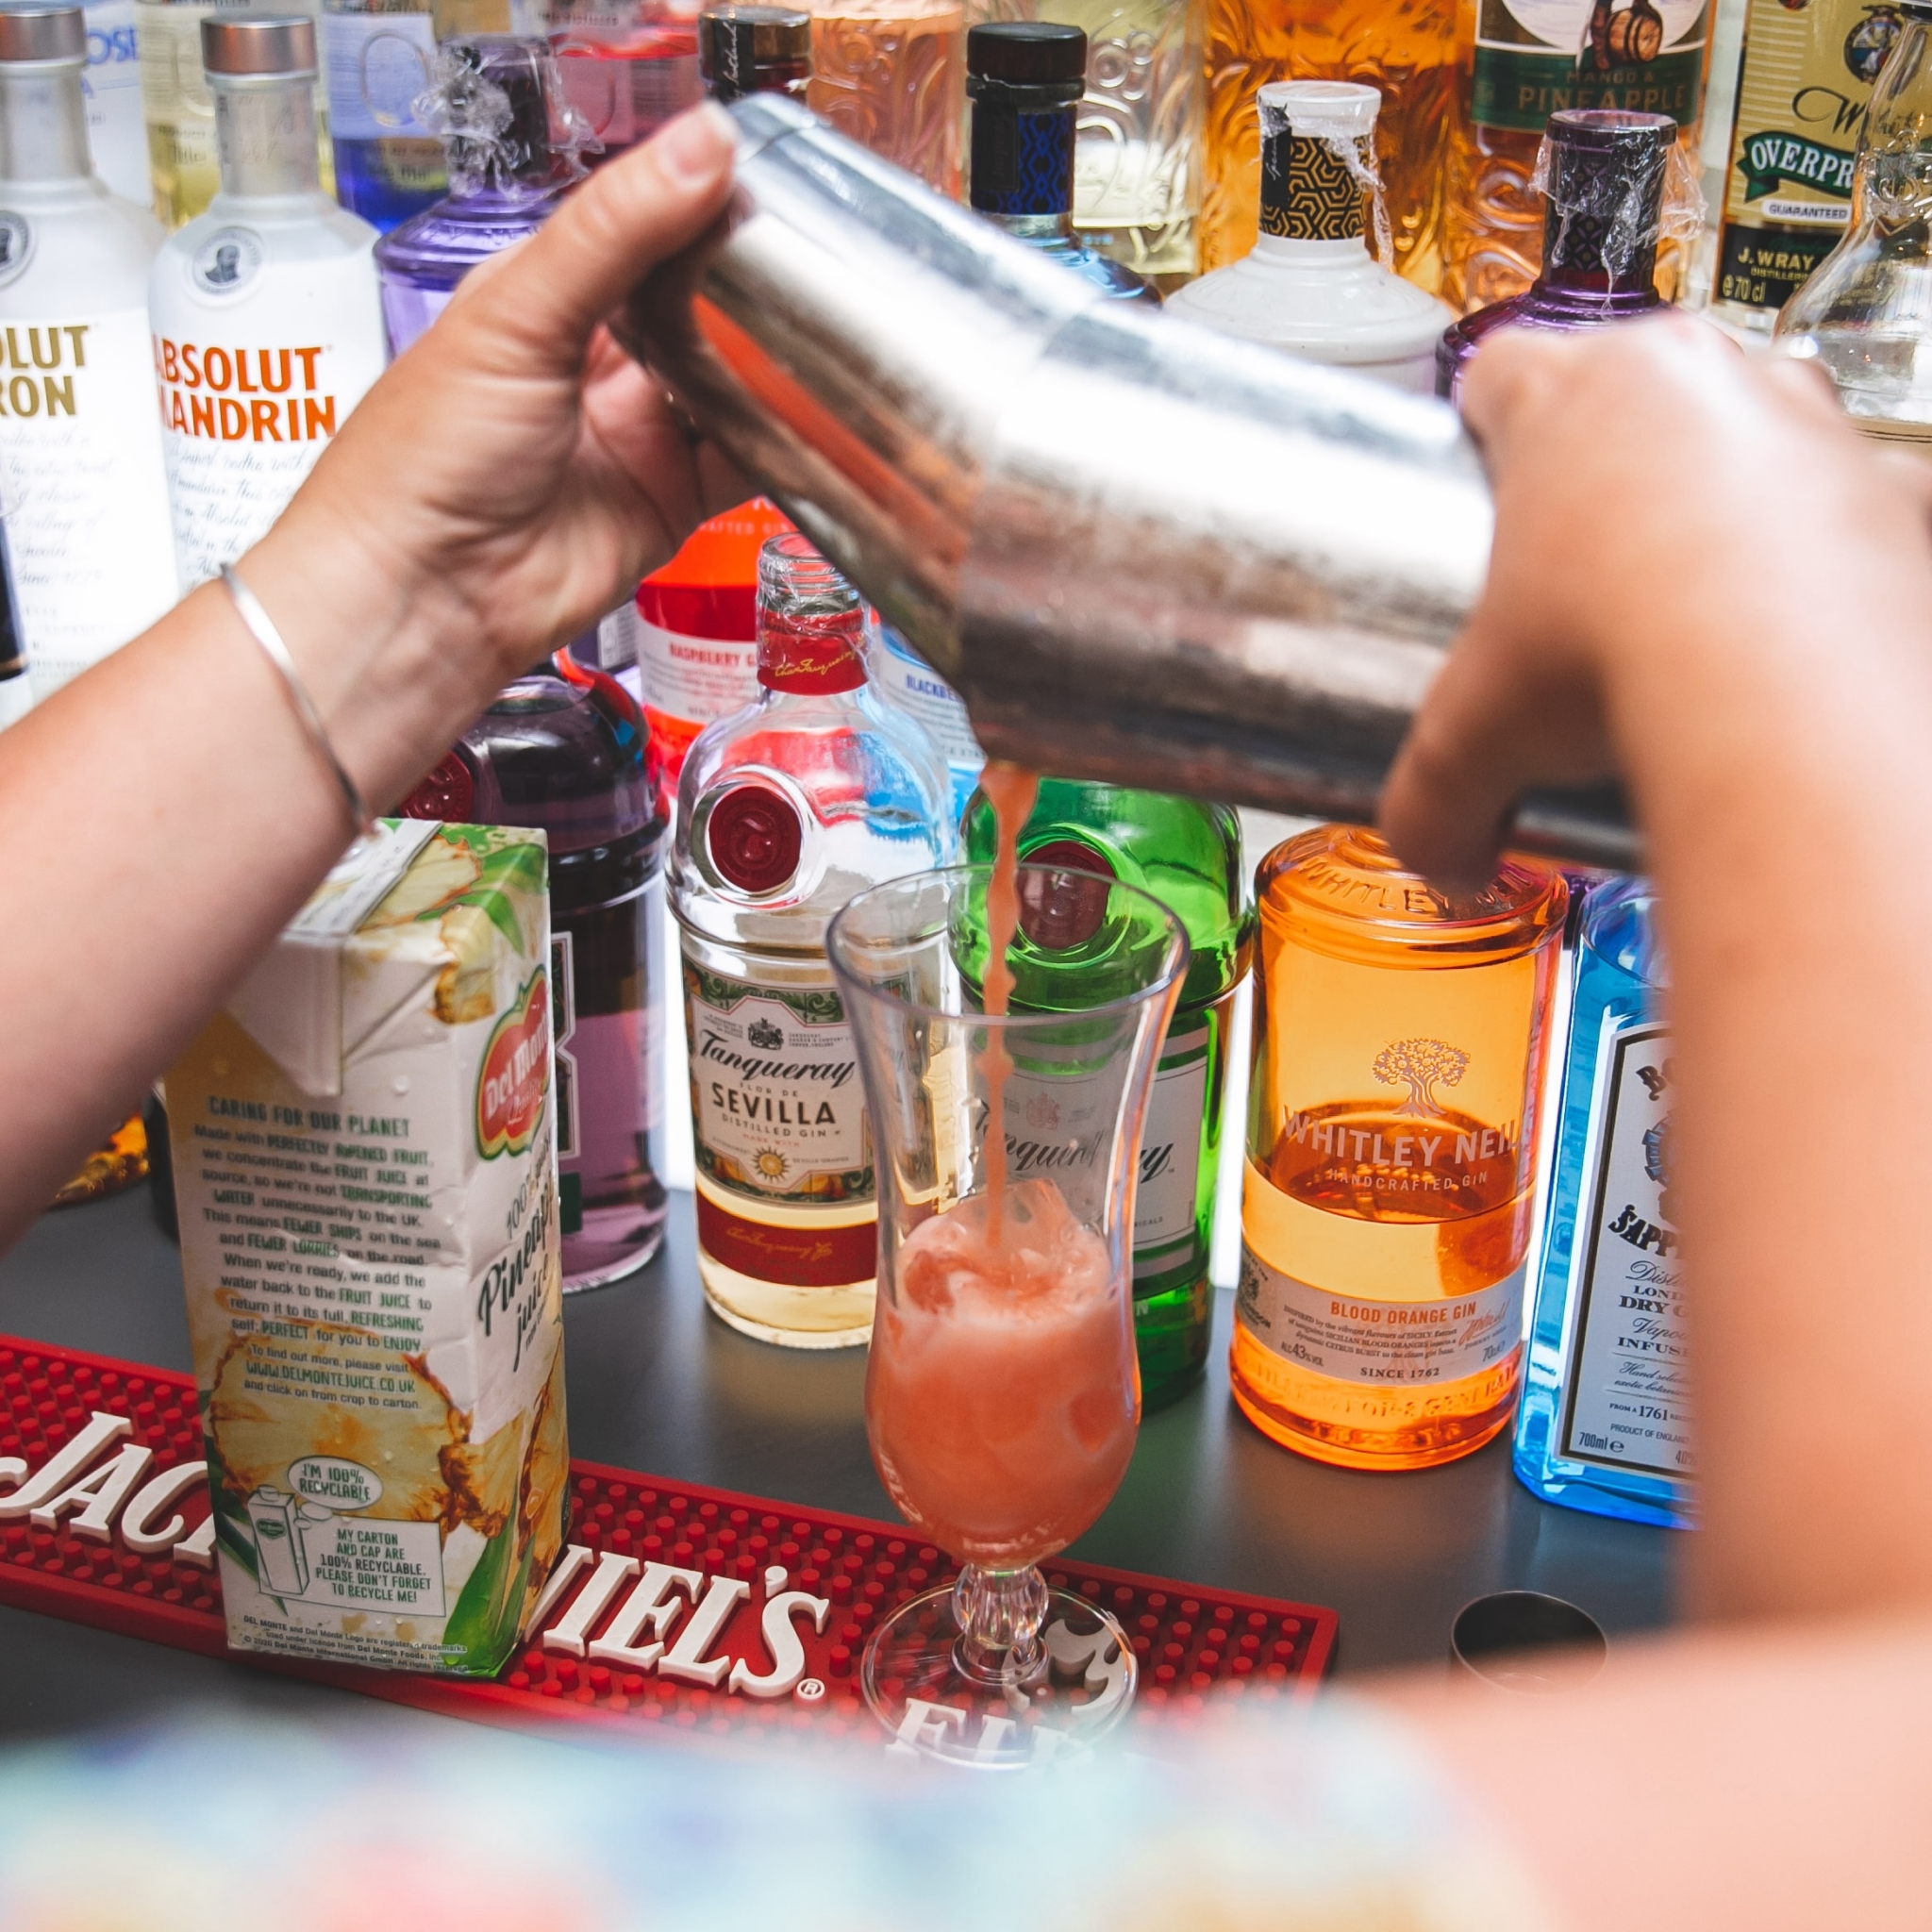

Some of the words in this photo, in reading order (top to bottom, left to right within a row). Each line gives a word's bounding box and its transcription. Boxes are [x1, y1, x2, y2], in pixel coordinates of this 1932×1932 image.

[1567, 70, 1637, 84] MANGO
[1519, 85, 1687, 114] PINEAPPLE
[1751, 139, 1855, 189] OVERPR
[1769, 205, 1848, 219] GUARANTEED
[1757, 250, 1814, 271] WRAY
[907, 674, 963, 703] BLACKBE
[699, 1028, 857, 1090] Tanqueray
[740, 1082, 773, 1095] FLOR
[782, 1089, 799, 1098] DE
[711, 1081, 837, 1125] SEVILLA
[208, 1094, 268, 1123] CARING
[308, 1110, 341, 1131] OUR
[347, 1115, 410, 1138] PLANET
[722, 1113, 791, 1137] DISTILLED
[799, 1128, 827, 1138] GIN
[1284, 1104, 1442, 1168] WHITLEY
[1329, 1169, 1453, 1191] HANDCRAFTED
[1462, 1171, 1488, 1188] GIN
[203, 1208, 232, 1224] This
[235, 1214, 283, 1229] means
[219, 1233, 245, 1246] and
[247, 1233, 288, 1252] FEWER
[225, 1252, 262, 1270] When
[266, 1259, 304, 1274] we're
[307, 1264, 347, 1283] ready,
[350, 1270, 371, 1283] we
[375, 1272, 400, 1285] add
[404, 1274, 426, 1288] the
[220, 1275, 258, 1291] water
[262, 1278, 294, 1295] back
[297, 1283, 311, 1297] to
[314, 1285, 337, 1301] the
[339, 1287, 373, 1306] FRUIT
[379, 1291, 413, 1309] JUICE
[420, 1297, 433, 1311] to
[1633, 1286, 1685, 1301] LOND
[230, 1297, 271, 1314] return
[274, 1302, 282, 1315] it
[286, 1303, 300, 1317] to
[303, 1305, 320, 1320] its
[349, 1310, 425, 1332] REFRESHING
[1330, 1301, 1381, 1324] BLOOD
[1387, 1307, 1448, 1325] ORANGE
[1453, 1301, 1476, 1321] GIN
[1619, 1295, 1670, 1315] DRY
[260, 1321, 309, 1341] PERFECT
[316, 1327, 334, 1342] for
[339, 1332, 363, 1347] you
[366, 1334, 381, 1348] to
[382, 1335, 422, 1352] ENJOY
[1338, 1324, 1365, 1336] vibrant
[1365, 1328, 1397, 1340] flavours
[251, 1343, 264, 1357] To
[267, 1346, 288, 1359] find
[291, 1350, 308, 1362] out
[344, 1357, 382, 1372] please
[386, 1361, 409, 1374] visit
[1324, 1341, 1355, 1354] CITRUS
[1355, 1347, 1381, 1357] BURST
[1360, 1366, 1405, 1378] SINCE
[1410, 1367, 1440, 1378] 1762
[1618, 1361, 1660, 1379] Hand
[243, 1378, 264, 1391] and
[266, 1382, 292, 1396] click
[293, 1387, 309, 1398] on
[311, 1389, 338, 1403] from
[340, 1393, 366, 1407] crop
[368, 1394, 380, 1407] to
[1614, 1378, 1643, 1391] exotic
[1609, 1402, 1631, 1412] FROM
[1639, 1405, 1669, 1422] 1761
[1579, 1431, 1609, 1451] 700ml
[1610, 1423, 1643, 1437] PRODUCT
[1645, 1429, 1656, 1439] OF
[302, 1462, 322, 1479] I'M
[328, 1466, 365, 1486] 100%
[299, 1478, 372, 1502] RECYCLABLE
[337, 1527, 355, 1543] MY
[357, 1529, 399, 1546] CARTON
[336, 1542, 358, 1557] AND
[360, 1543, 381, 1558] CAP
[385, 1546, 406, 1560] ARE
[320, 1553, 353, 1570] 100%
[355, 1558, 426, 1577] RECYCLABLE.
[315, 1566, 354, 1584] PLEASE
[357, 1572, 389, 1588] DON'T
[391, 1575, 432, 1591] FORGET
[331, 1582, 344, 1596] TO
[347, 1583, 394, 1602] RECYCLE
[397, 1590, 418, 1604] ME!
[243, 1614, 258, 1625] DEL
[259, 1619, 288, 1631] MONTE
[289, 1625, 304, 1634] and
[305, 1626, 318, 1636] Del
[320, 1629, 343, 1640] Monte
[345, 1632, 365, 1643] Logo
[253, 1637, 274, 1647] 2020
[274, 1641, 289, 1650] Del
[289, 1643, 315, 1654] Monte
[316, 1648, 368, 1661] International
[285, 1635, 308, 1644] under
[308, 1637, 336, 1648] license
[337, 1641, 357, 1651] from
[357, 1644, 371, 1653] Del
[373, 1646, 398, 1657] Monte
